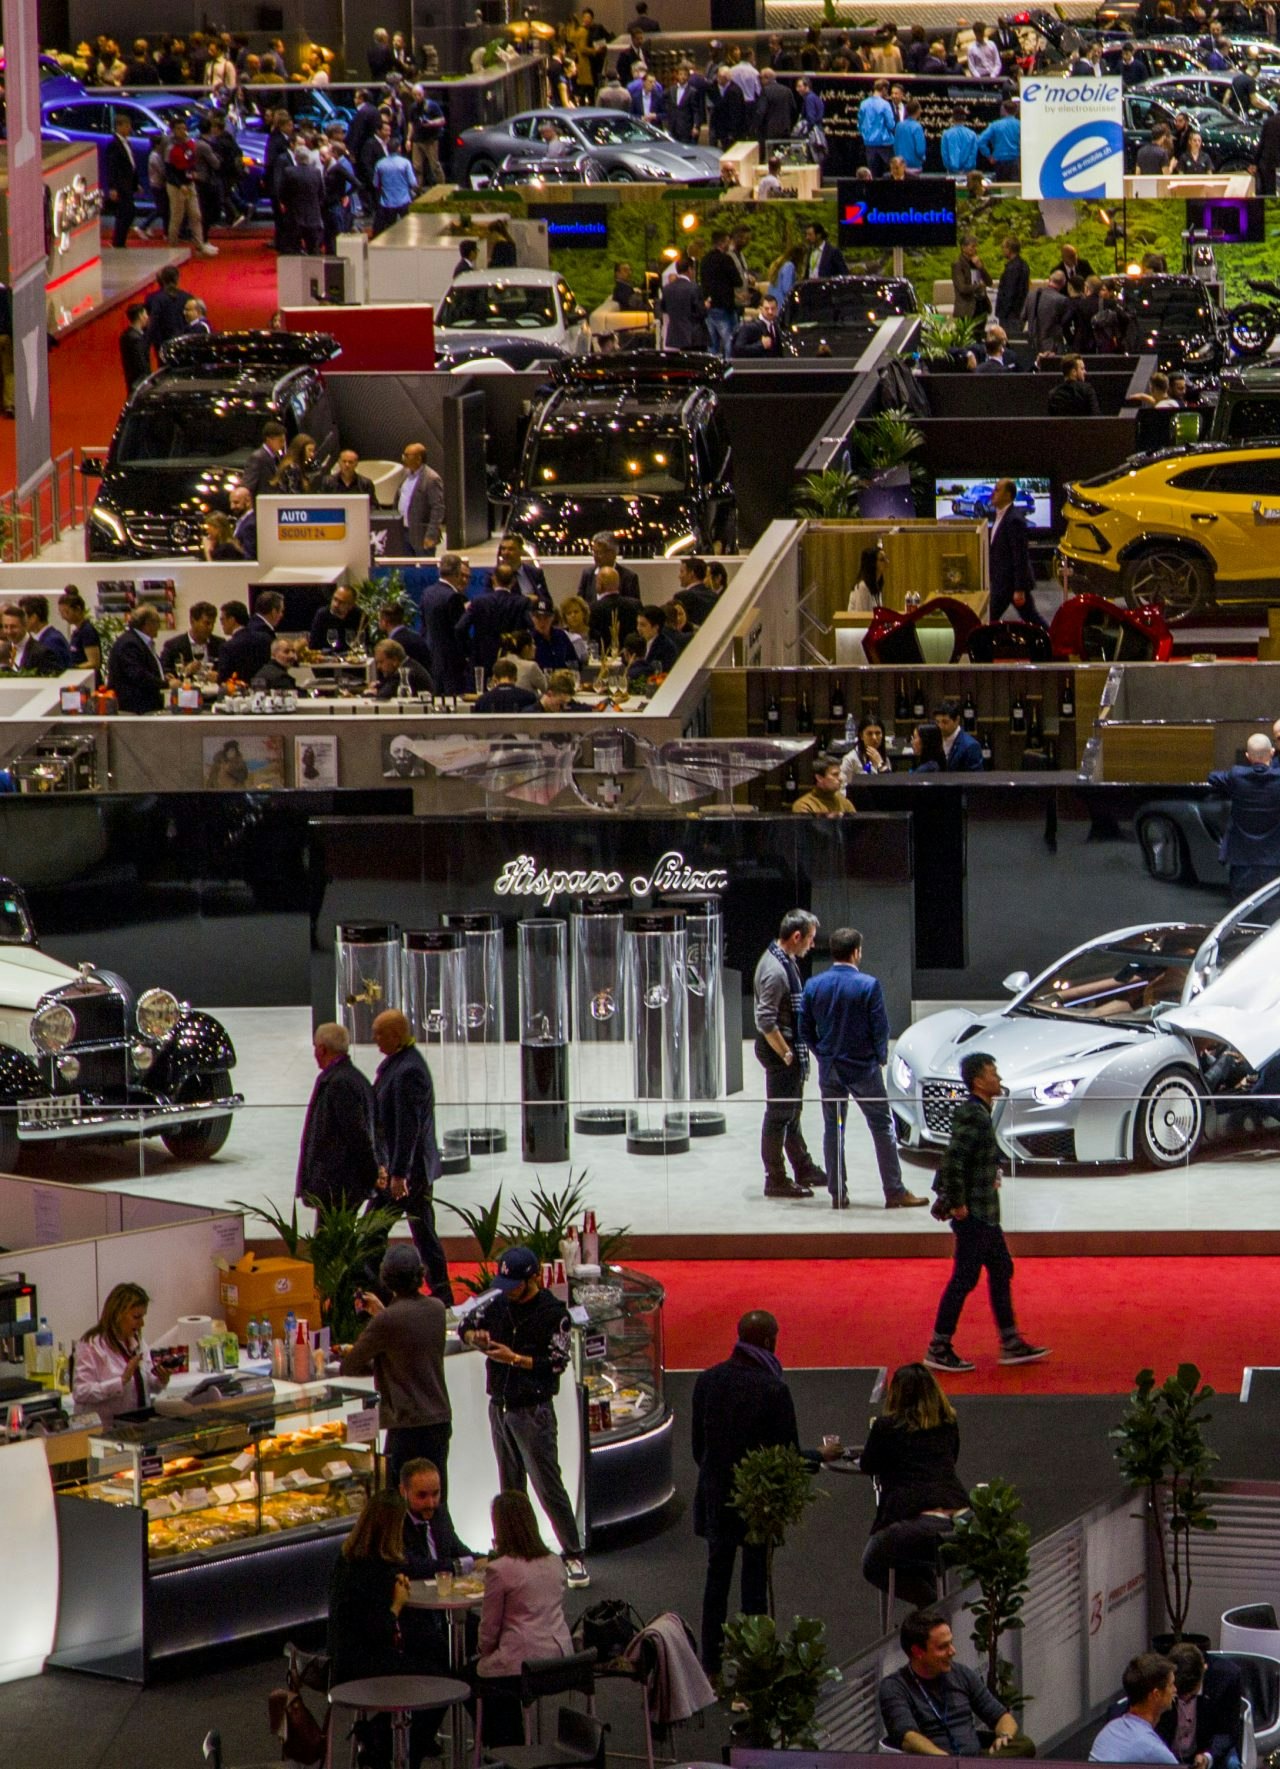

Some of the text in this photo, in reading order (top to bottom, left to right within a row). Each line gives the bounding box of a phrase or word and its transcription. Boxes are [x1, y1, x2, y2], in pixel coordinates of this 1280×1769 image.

[1060, 104, 1117, 113] electrosuisse
[867, 207, 954, 224] demelectric
[281, 511, 308, 523] AUTO
[281, 529, 326, 538] SCOUT 24
[494, 851, 729, 907] Hispano Suiza
